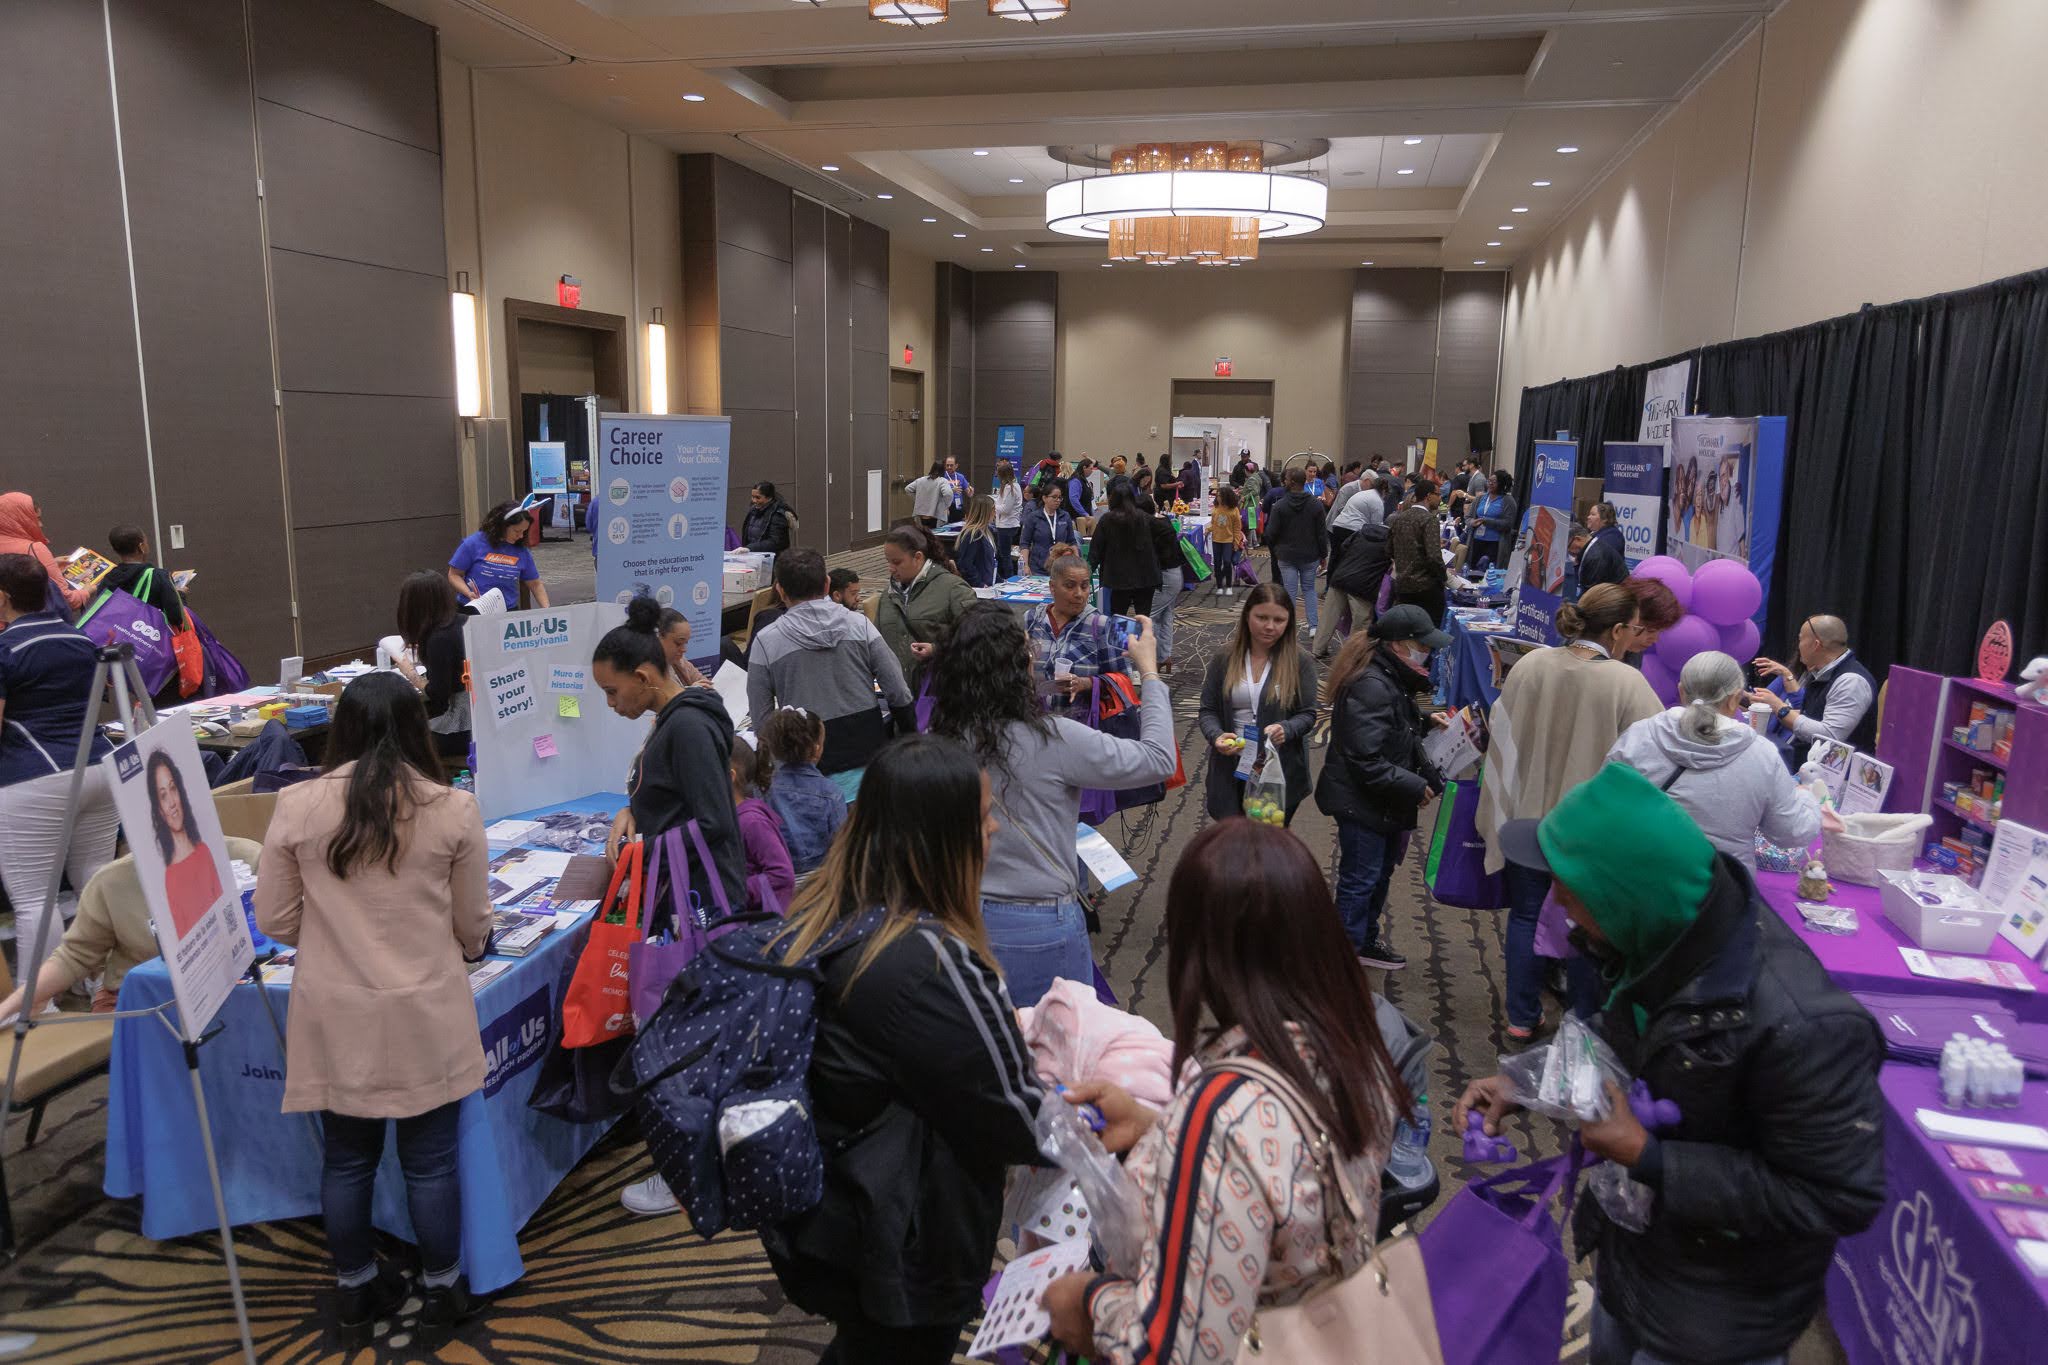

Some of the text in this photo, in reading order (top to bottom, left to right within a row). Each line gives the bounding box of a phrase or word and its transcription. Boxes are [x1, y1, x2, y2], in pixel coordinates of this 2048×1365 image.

[610, 427, 663, 445] Career
[610, 447, 663, 465] Choice
[1615, 505, 1637, 519] ver
[612, 522, 625, 534] 90
[623, 553, 705, 568] Choose the education track
[634, 568, 648, 577] that
[655, 566, 670, 576] right
[671, 564, 680, 573] for
[681, 564, 695, 575] you.
[1519, 600, 1544, 623] Certificate
[113, 624, 131, 636] Health
[130, 633, 152, 649] Partners
[504, 617, 568, 640] All of Us
[1518, 620, 1538, 640] Spanish
[504, 634, 569, 651] Pennsylvania
[489, 669, 526, 689] Share
[553, 669, 584, 679] Muro de
[497, 684, 526, 705] your
[551, 681, 584, 690] historias
[498, 696, 534, 719] story!
[486, 1035, 509, 1073] All
[521, 1016, 546, 1046] Us
[241, 1064, 283, 1081] Join
[485, 1059, 515, 1088] ESEARCH
